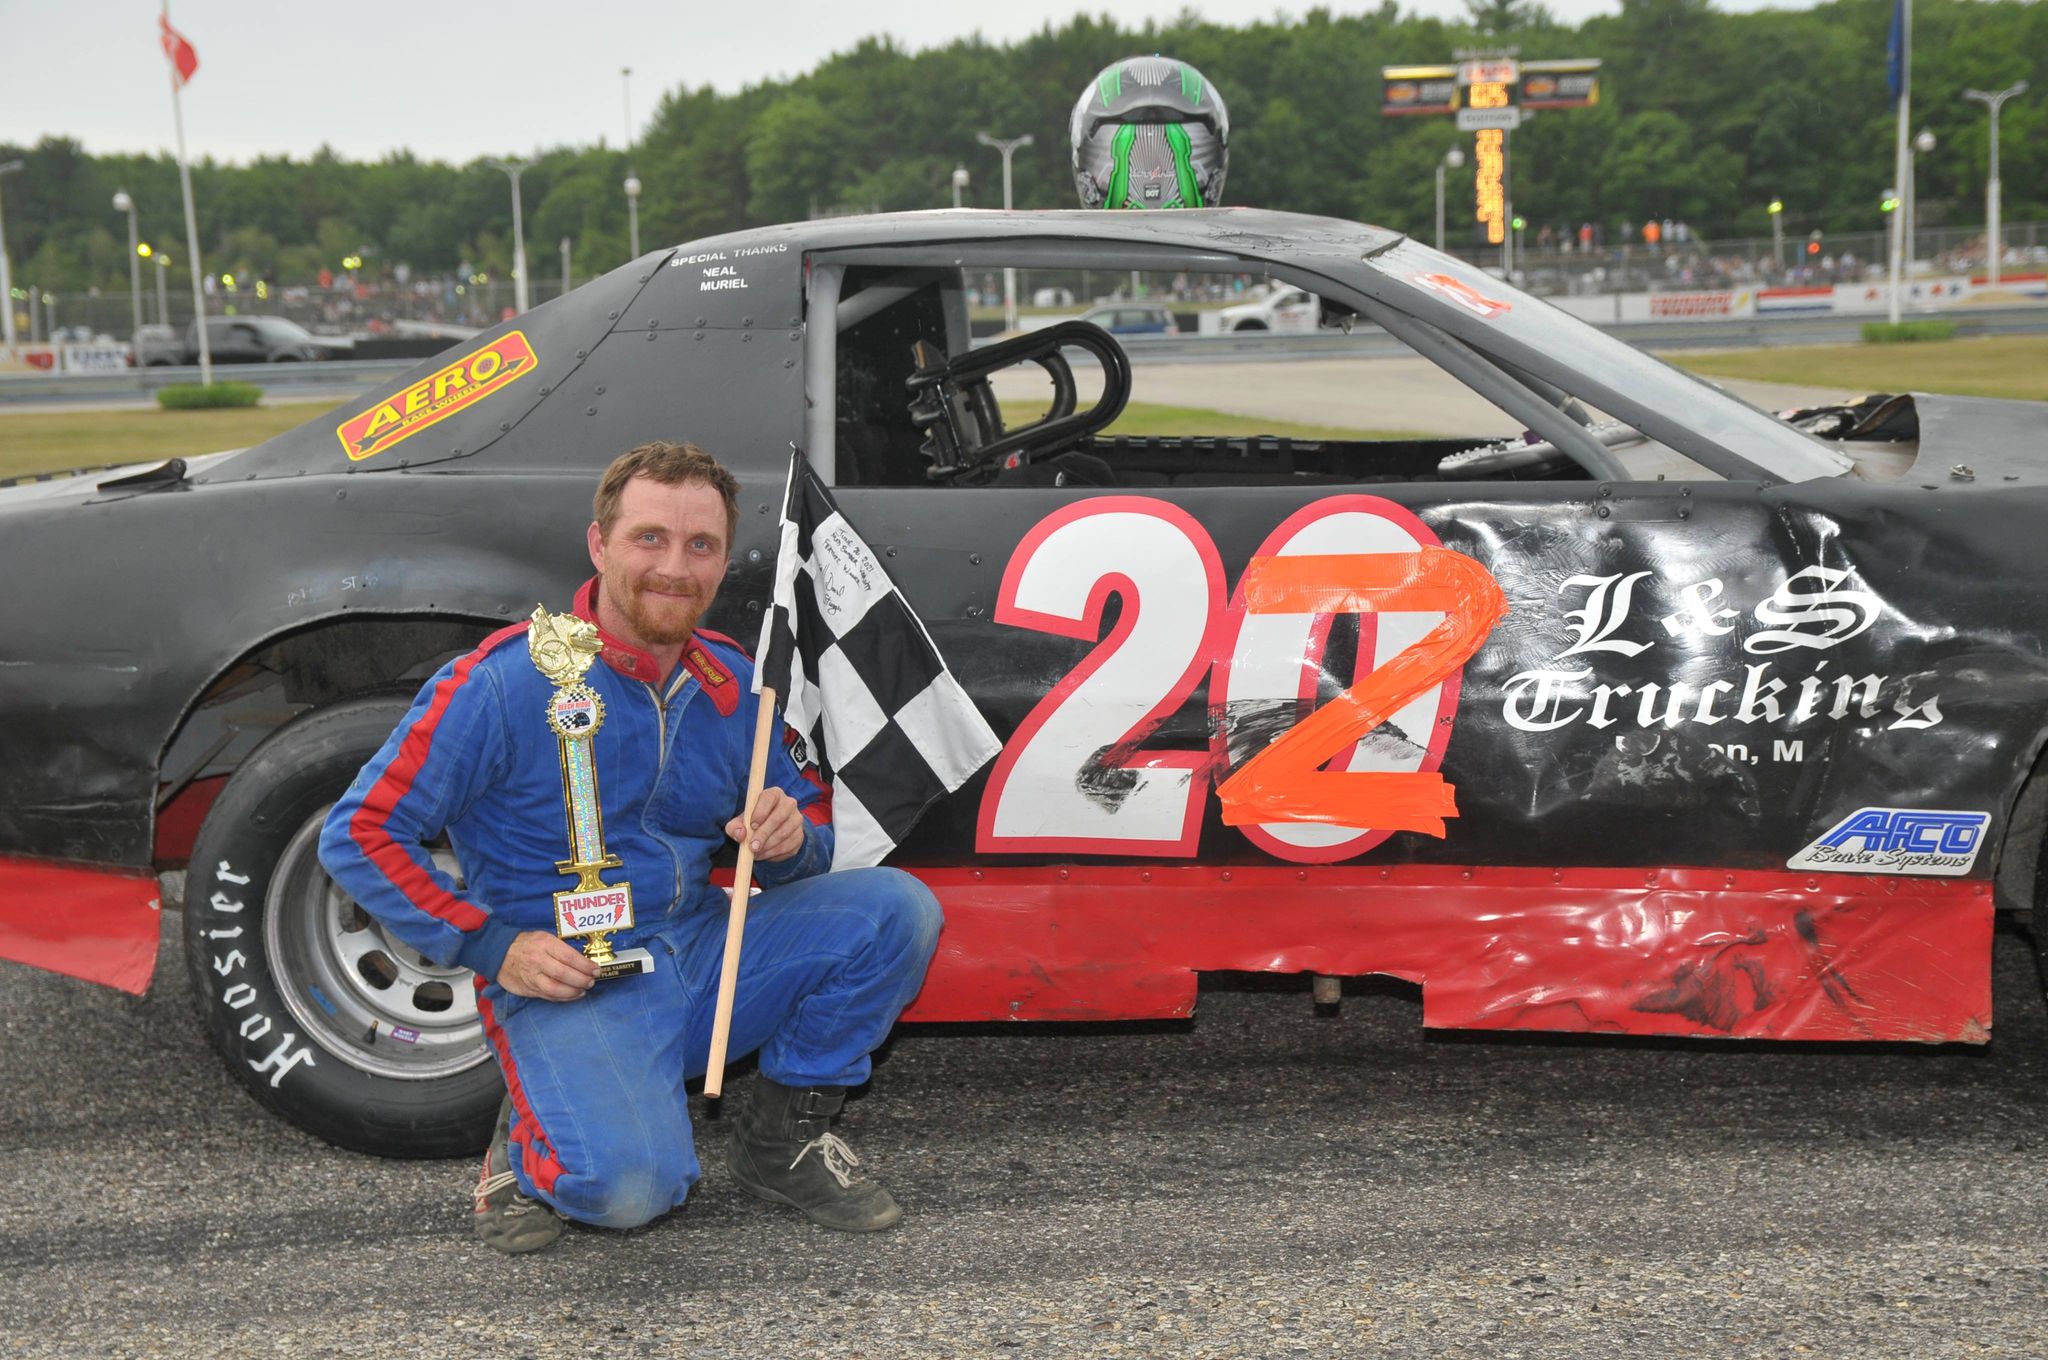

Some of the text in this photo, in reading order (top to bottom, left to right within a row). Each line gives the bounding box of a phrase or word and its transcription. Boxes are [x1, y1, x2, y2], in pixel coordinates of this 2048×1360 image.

[671, 243, 788, 267] SPECIAL THANKS
[700, 278, 748, 291] MURIEL
[702, 266, 737, 277] NEAL
[364, 350, 502, 439] AERO
[1554, 565, 1882, 660] L & S
[1501, 660, 1944, 732] Trucking
[1818, 810, 1987, 855] AFCO
[1805, 844, 1973, 871] Brake Systems
[560, 892, 626, 912] THUNDER
[578, 912, 613, 928] 2021
[199, 860, 317, 1088] Hoosier
